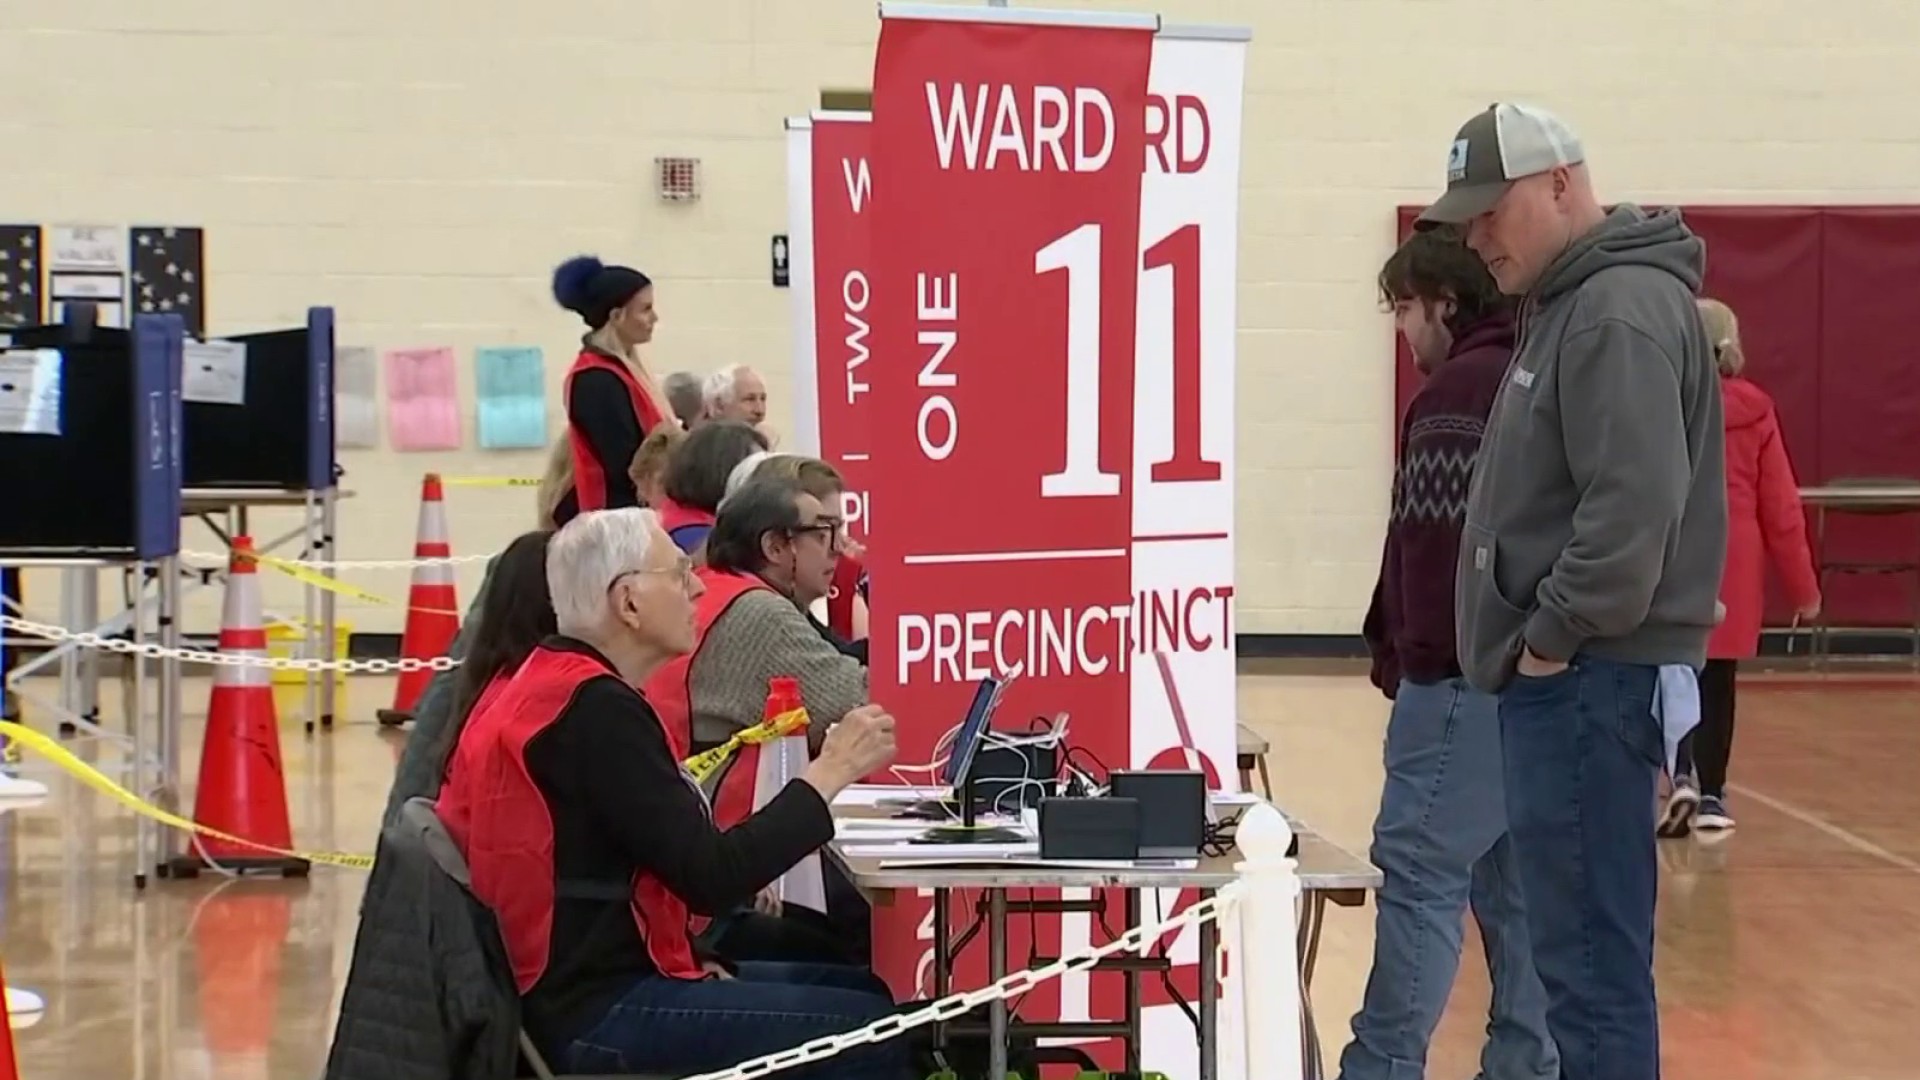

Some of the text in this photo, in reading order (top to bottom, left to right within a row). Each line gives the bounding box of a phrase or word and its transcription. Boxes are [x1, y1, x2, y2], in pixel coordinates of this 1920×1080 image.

[924, 81, 1116, 173] WARD
[1142, 94, 1211, 174] RD
[842, 269, 870, 405] TWO
[916, 271, 959, 461] ONE
[1034, 222, 1121, 498] 1
[1142, 223, 1222, 484] 1
[897, 604, 1132, 686] PRECINCT
[1138, 586, 1234, 655] INCT
